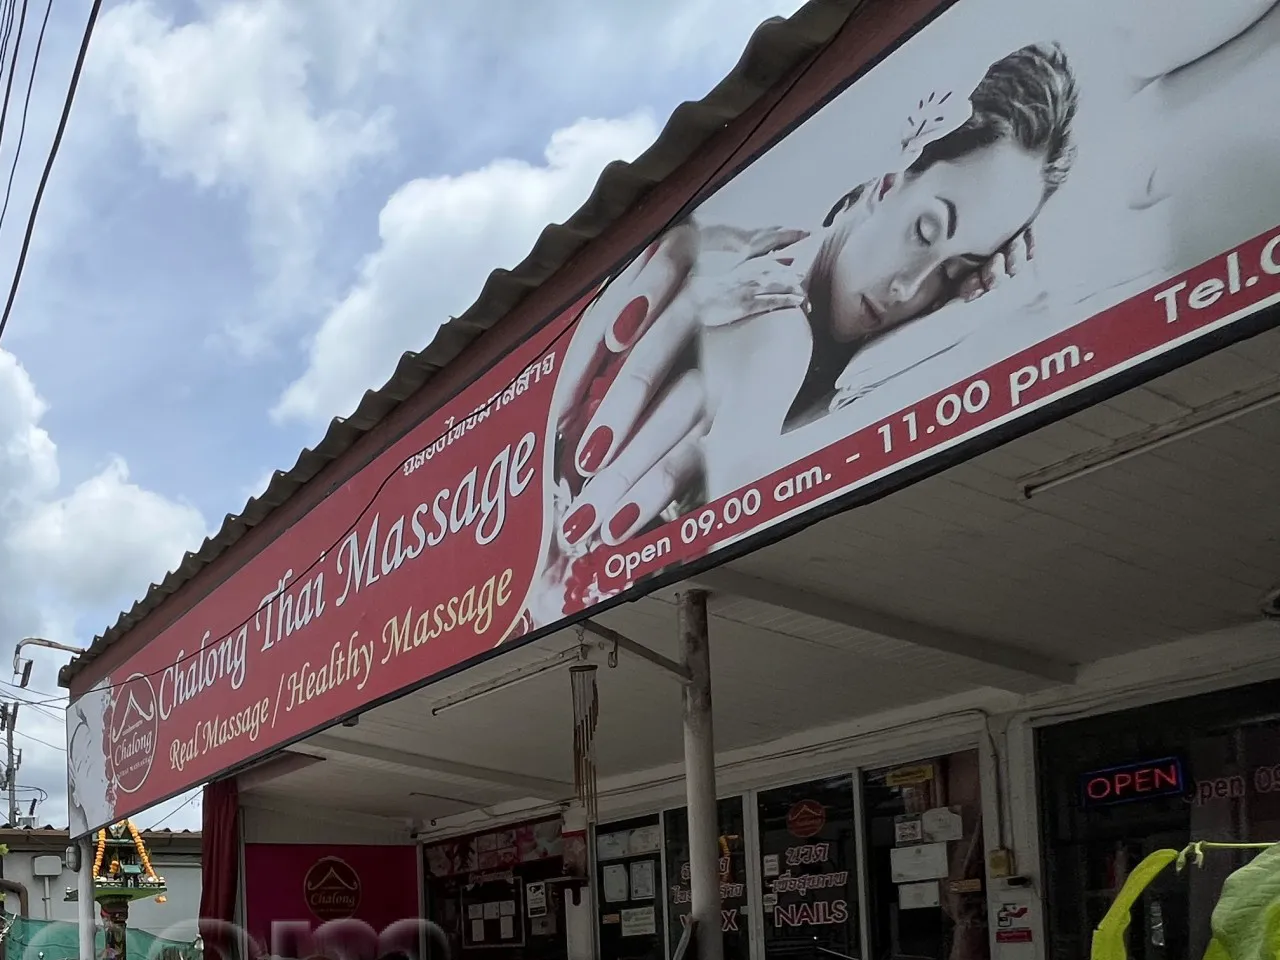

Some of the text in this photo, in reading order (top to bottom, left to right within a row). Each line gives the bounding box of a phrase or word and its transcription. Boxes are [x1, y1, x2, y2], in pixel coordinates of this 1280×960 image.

[604, 536, 671, 579] Open
[680, 488, 762, 545] 09.00
[773, 466, 832, 502] am.
[877, 379, 990, 453] 11.00
[1009, 344, 1096, 408] pm.
[159, 431, 537, 720] Chalong Thai Massage
[170, 721, 202, 772] Real
[202, 696, 269, 755] Massage
[286, 631, 375, 712] Healthy
[381, 568, 513, 664] Massage
[114, 731, 153, 767] Chalong
[1087, 763, 1178, 799] OPEN
[785, 843, 829, 865] นวด
[310, 891, 355, 907] Chalong
[774, 900, 848, 927] NAILS
